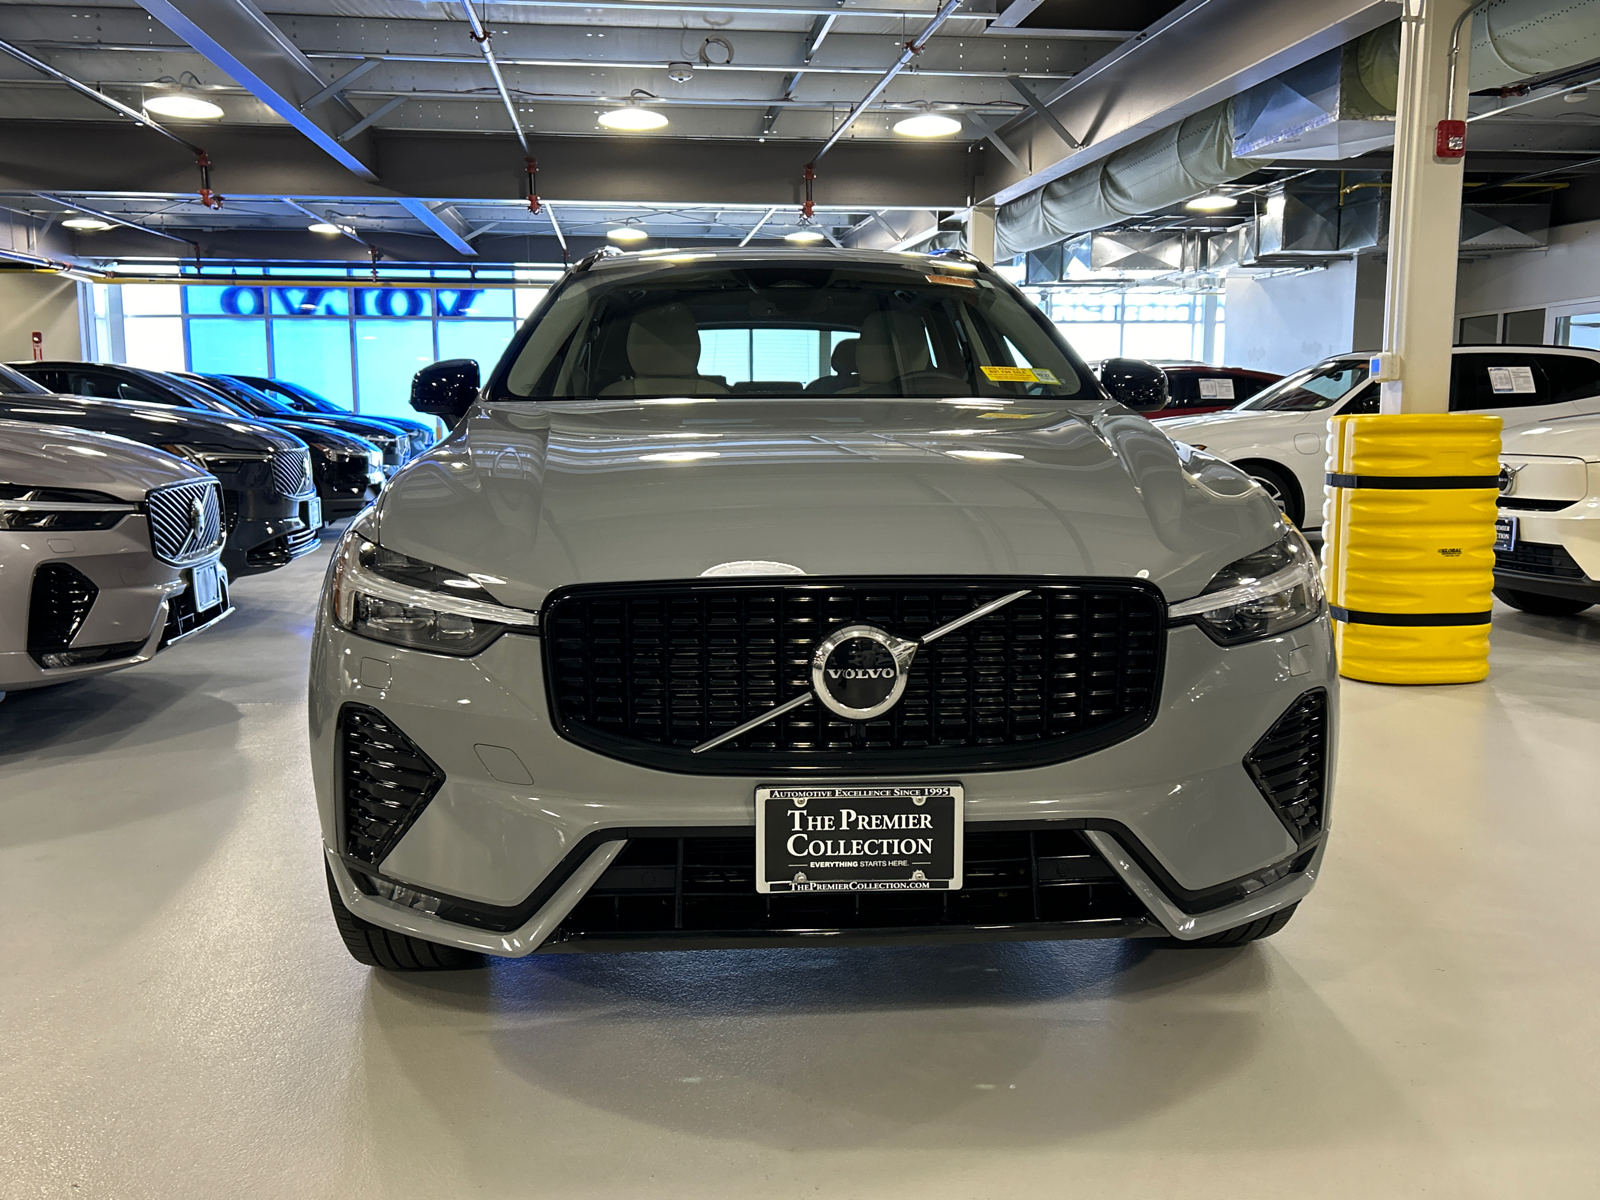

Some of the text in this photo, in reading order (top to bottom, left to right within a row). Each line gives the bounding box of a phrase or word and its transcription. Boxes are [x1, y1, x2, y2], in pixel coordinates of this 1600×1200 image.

[826, 668, 895, 679] VOLVO
[772, 788, 949, 798] AUTOMOTIVE EXCELLENCE SINCE 1995
[787, 809, 933, 831] THE PREMIER
[786, 833, 934, 857] COLLECTION
[810, 860, 858, 868] EVERYTHING
